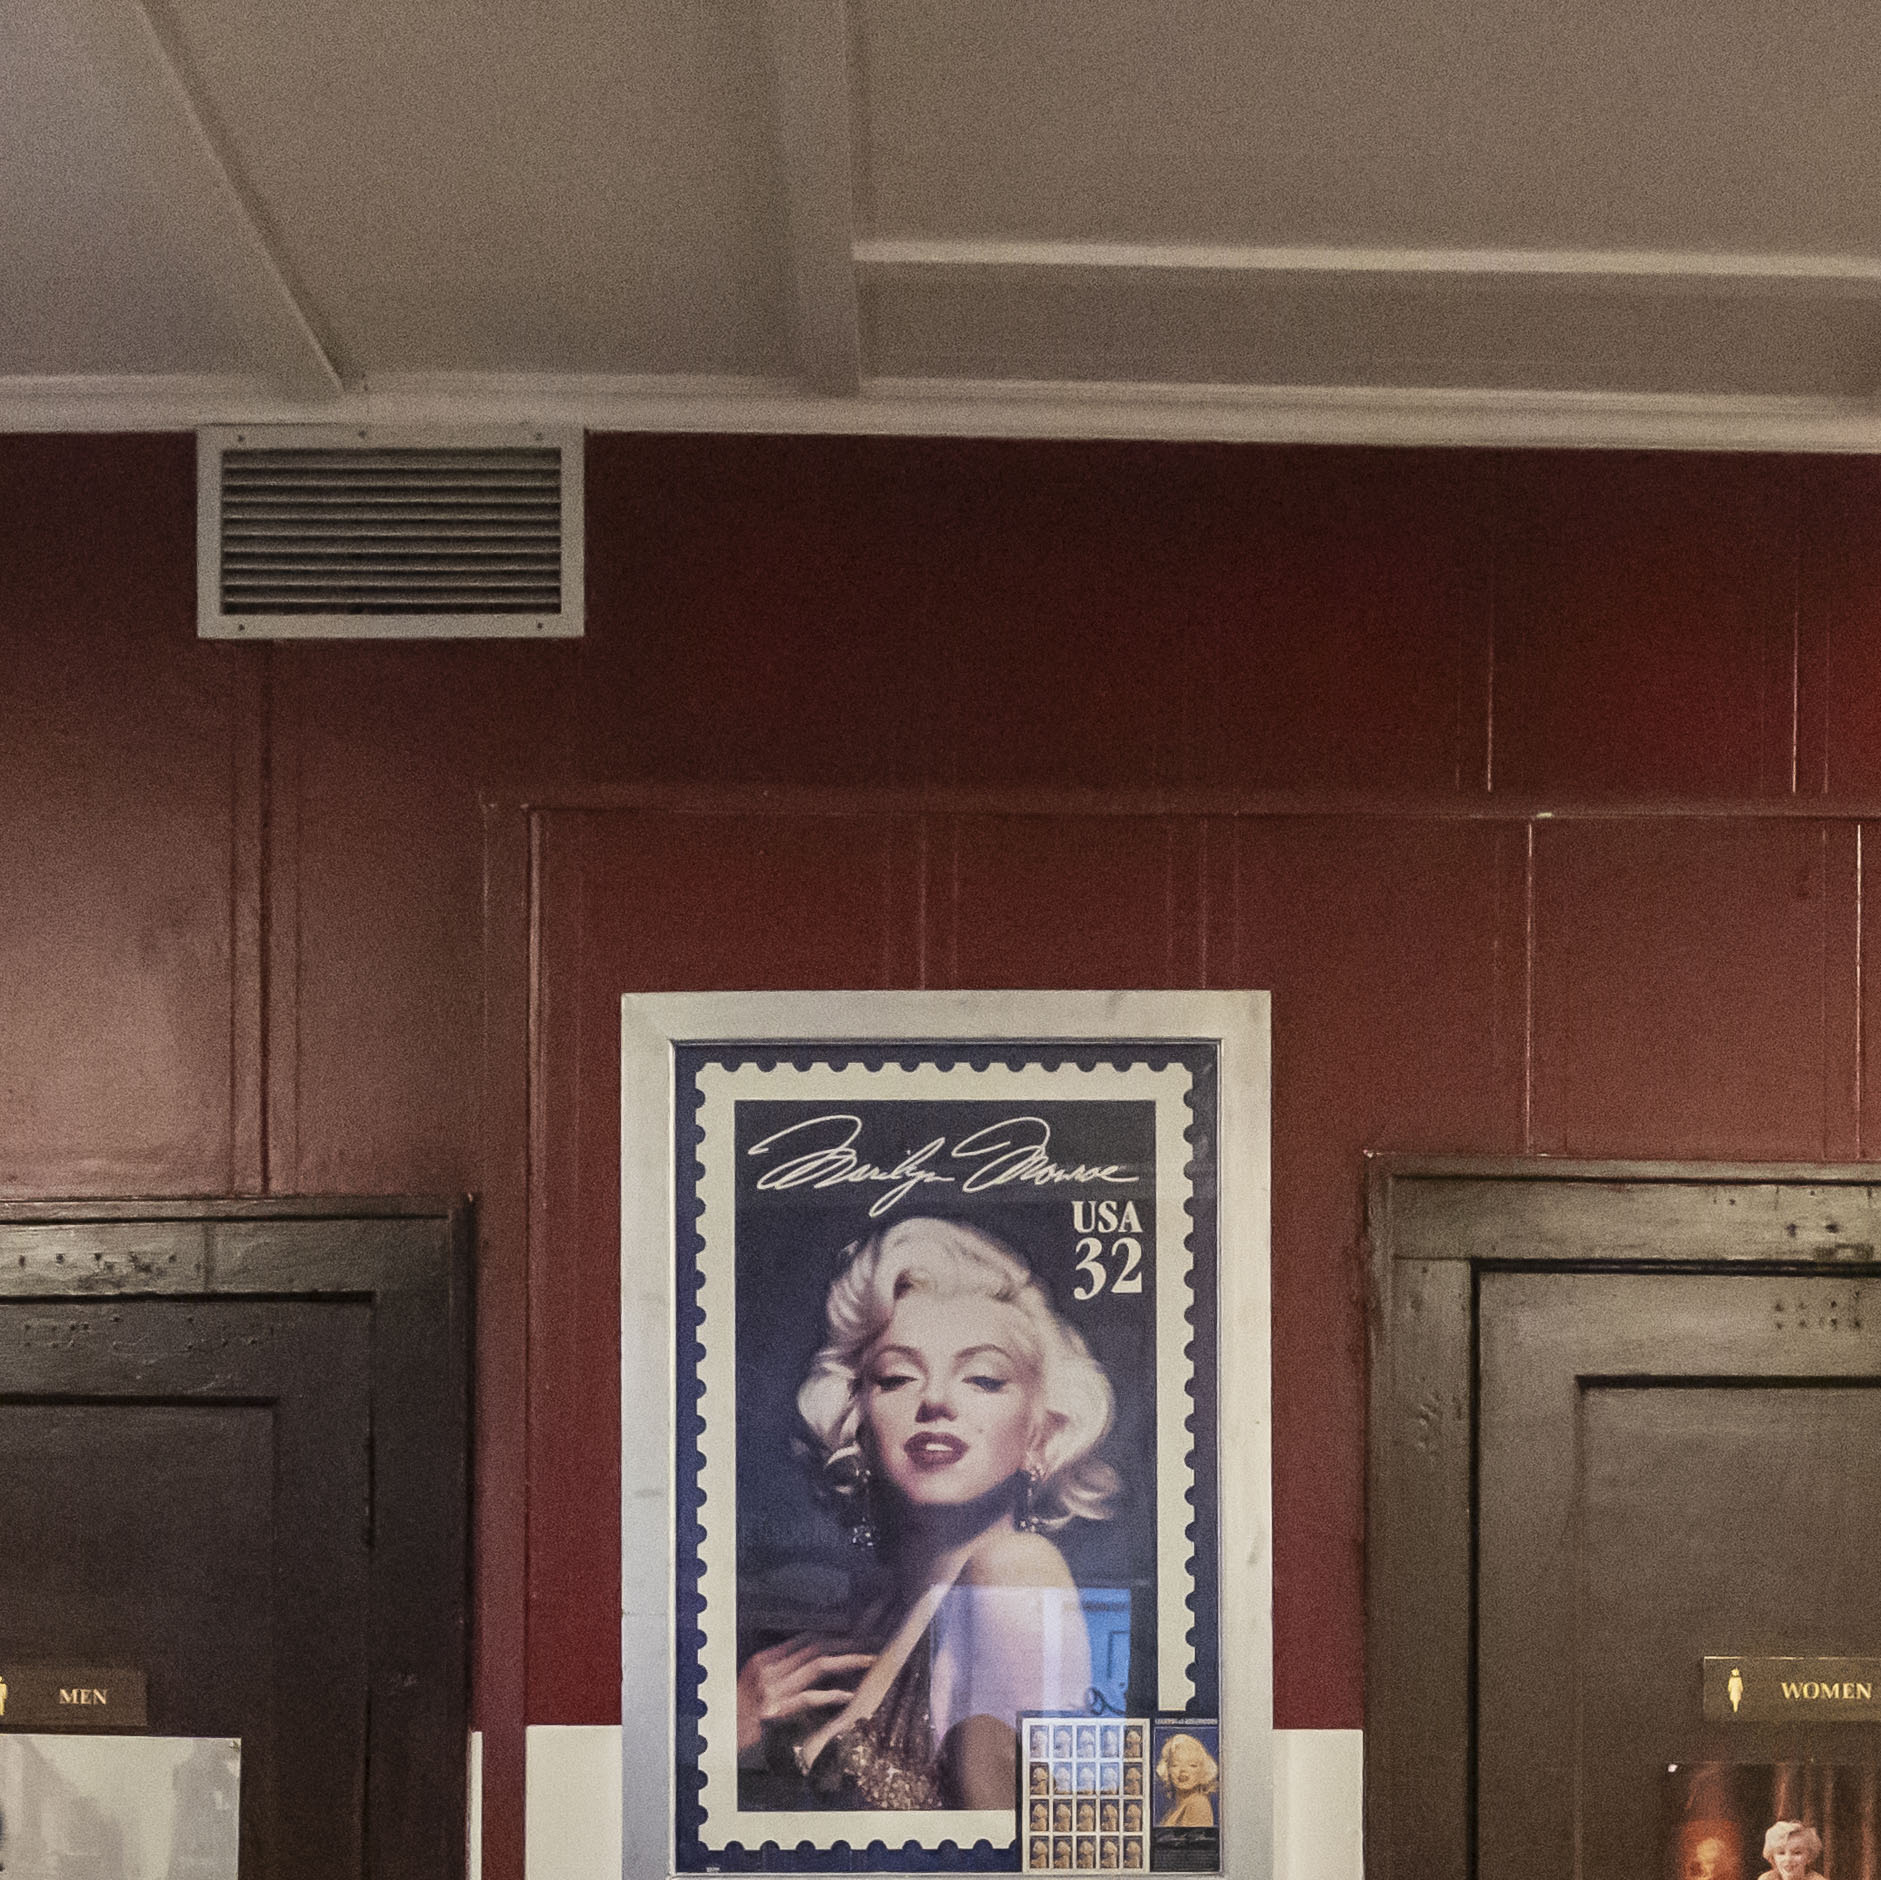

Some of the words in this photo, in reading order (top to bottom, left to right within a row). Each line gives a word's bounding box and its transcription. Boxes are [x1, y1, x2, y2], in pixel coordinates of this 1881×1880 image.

[748, 1114, 955, 1217] Marilyn
[951, 1116, 1140, 1193] Monroe
[1071, 1201, 1143, 1233] USA
[1072, 1237, 1143, 1300] 32
[59, 1688, 108, 1704] MEN
[1781, 1682, 1872, 1699] WOMEN
